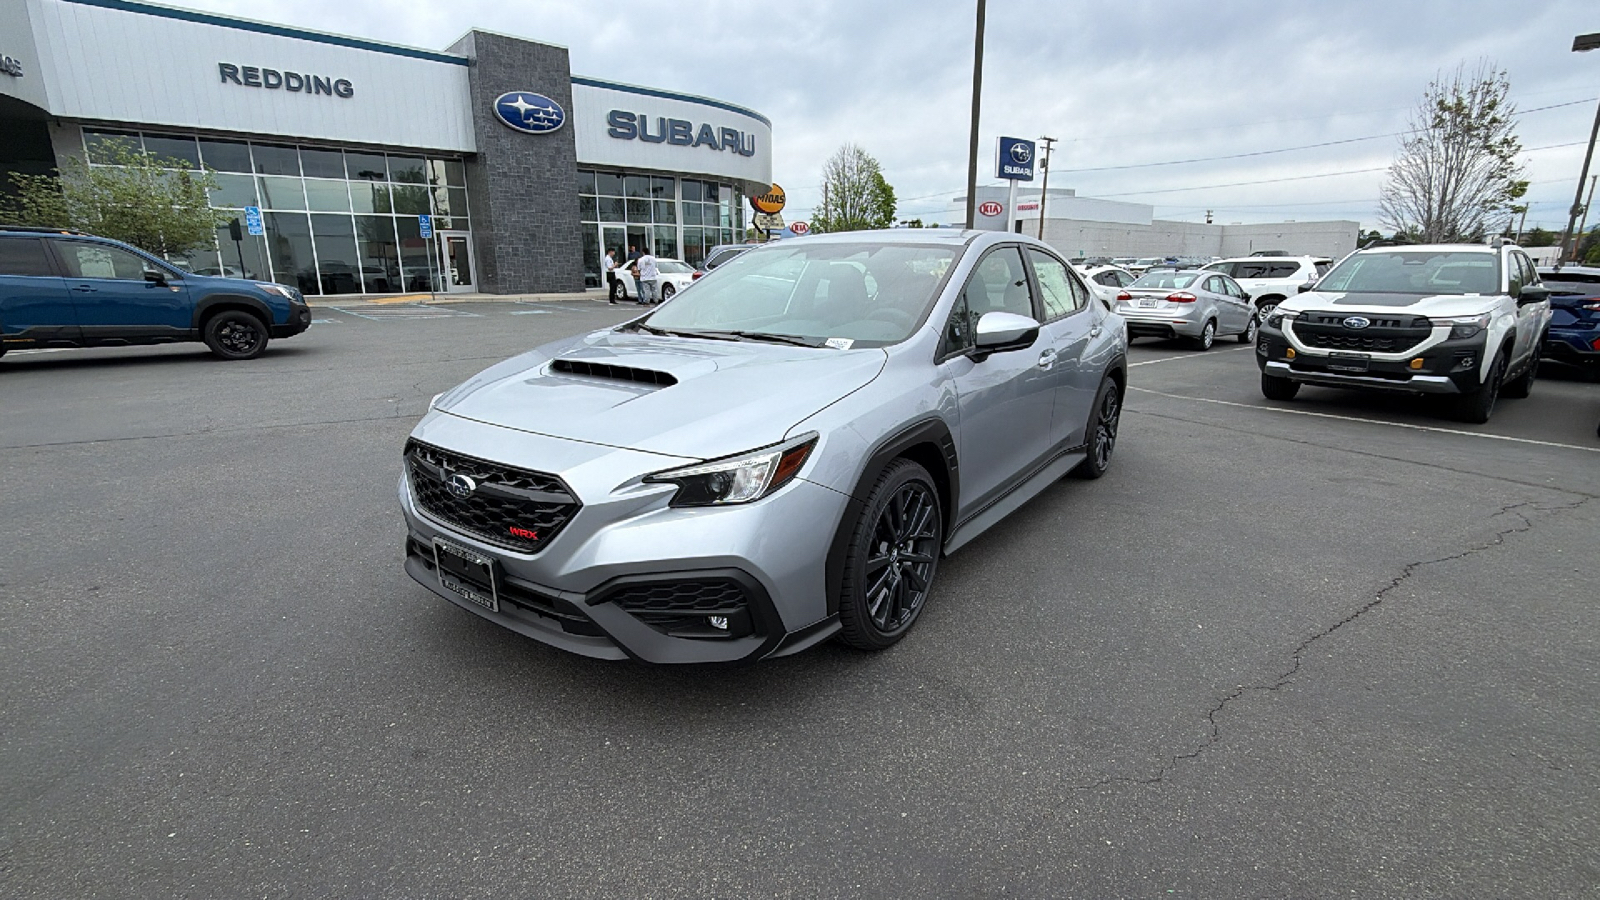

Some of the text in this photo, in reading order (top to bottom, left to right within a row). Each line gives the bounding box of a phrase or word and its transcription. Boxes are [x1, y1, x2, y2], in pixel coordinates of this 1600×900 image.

[218, 62, 355, 98] REDDING
[608, 109, 756, 156] SUBARU
[1003, 165, 1033, 176] SUBARU
[757, 193, 785, 204] MIDAS
[983, 204, 999, 213] KIA
[509, 526, 539, 541] WRX
